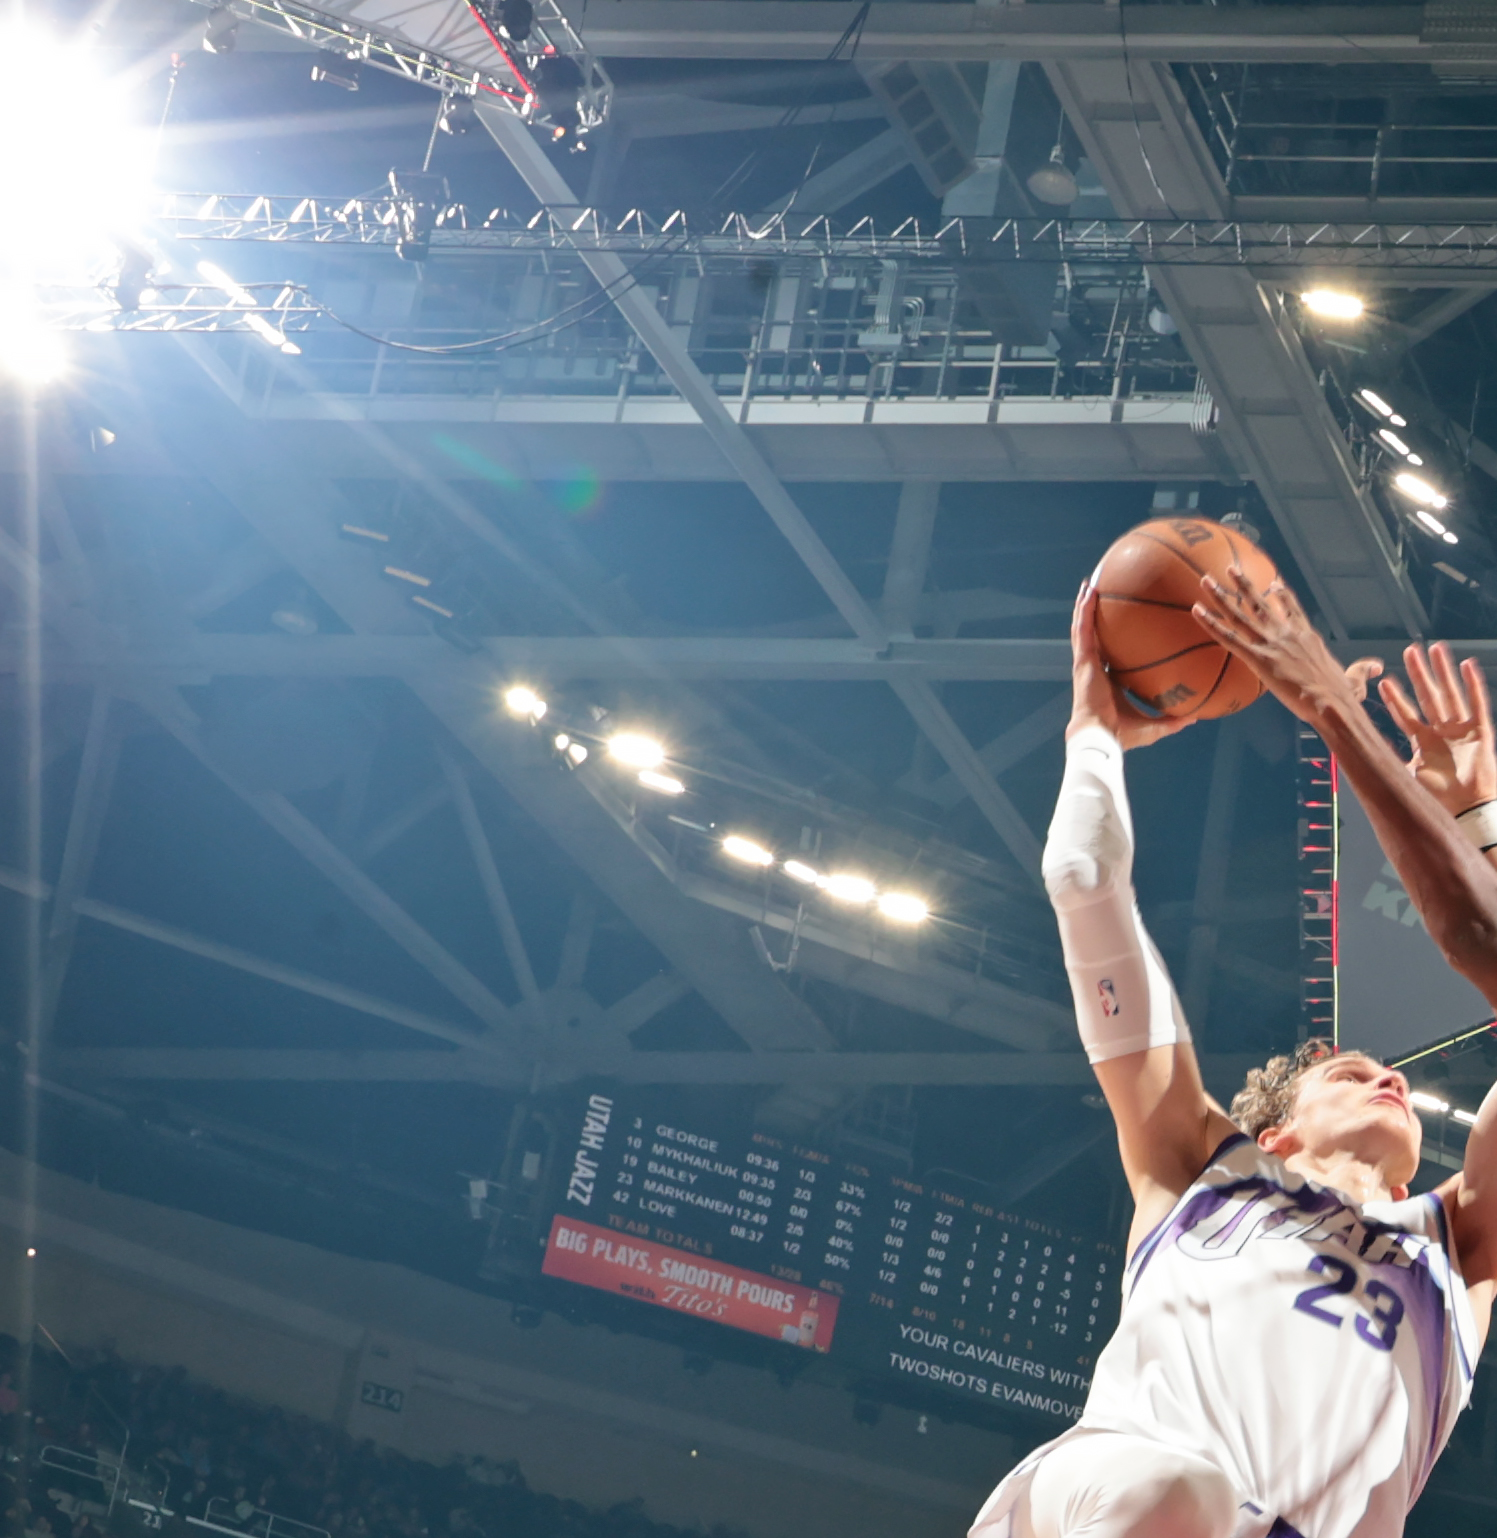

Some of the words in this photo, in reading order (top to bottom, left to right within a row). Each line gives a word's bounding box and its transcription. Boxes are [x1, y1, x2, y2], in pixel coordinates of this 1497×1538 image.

[581, 1094, 613, 1150] UTAH
[656, 1125, 719, 1153] GEORGE
[567, 1150, 599, 1206] JAZZ
[648, 1161, 698, 1184] BAILEY
[652, 1142, 738, 1179] MYKHAILIUK
[639, 1198, 676, 1218] LOVE
[643, 1179, 733, 1216] MARKKANEN
[555, 1227, 588, 1254] BIG
[592, 1238, 653, 1275] PLAYS,
[658, 1258, 735, 1296] SMOOTH
[737, 1279, 796, 1314] POURS
[662, 1284, 729, 1317] Tito's
[1293, 1254, 1405, 1352] 23
[890, 1353, 988, 1394] TWOSHOTS
[900, 1324, 950, 1352] YOUR
[953, 1340, 1045, 1379] CAVALIERS
[1050, 1367, 1091, 1392] WITH
